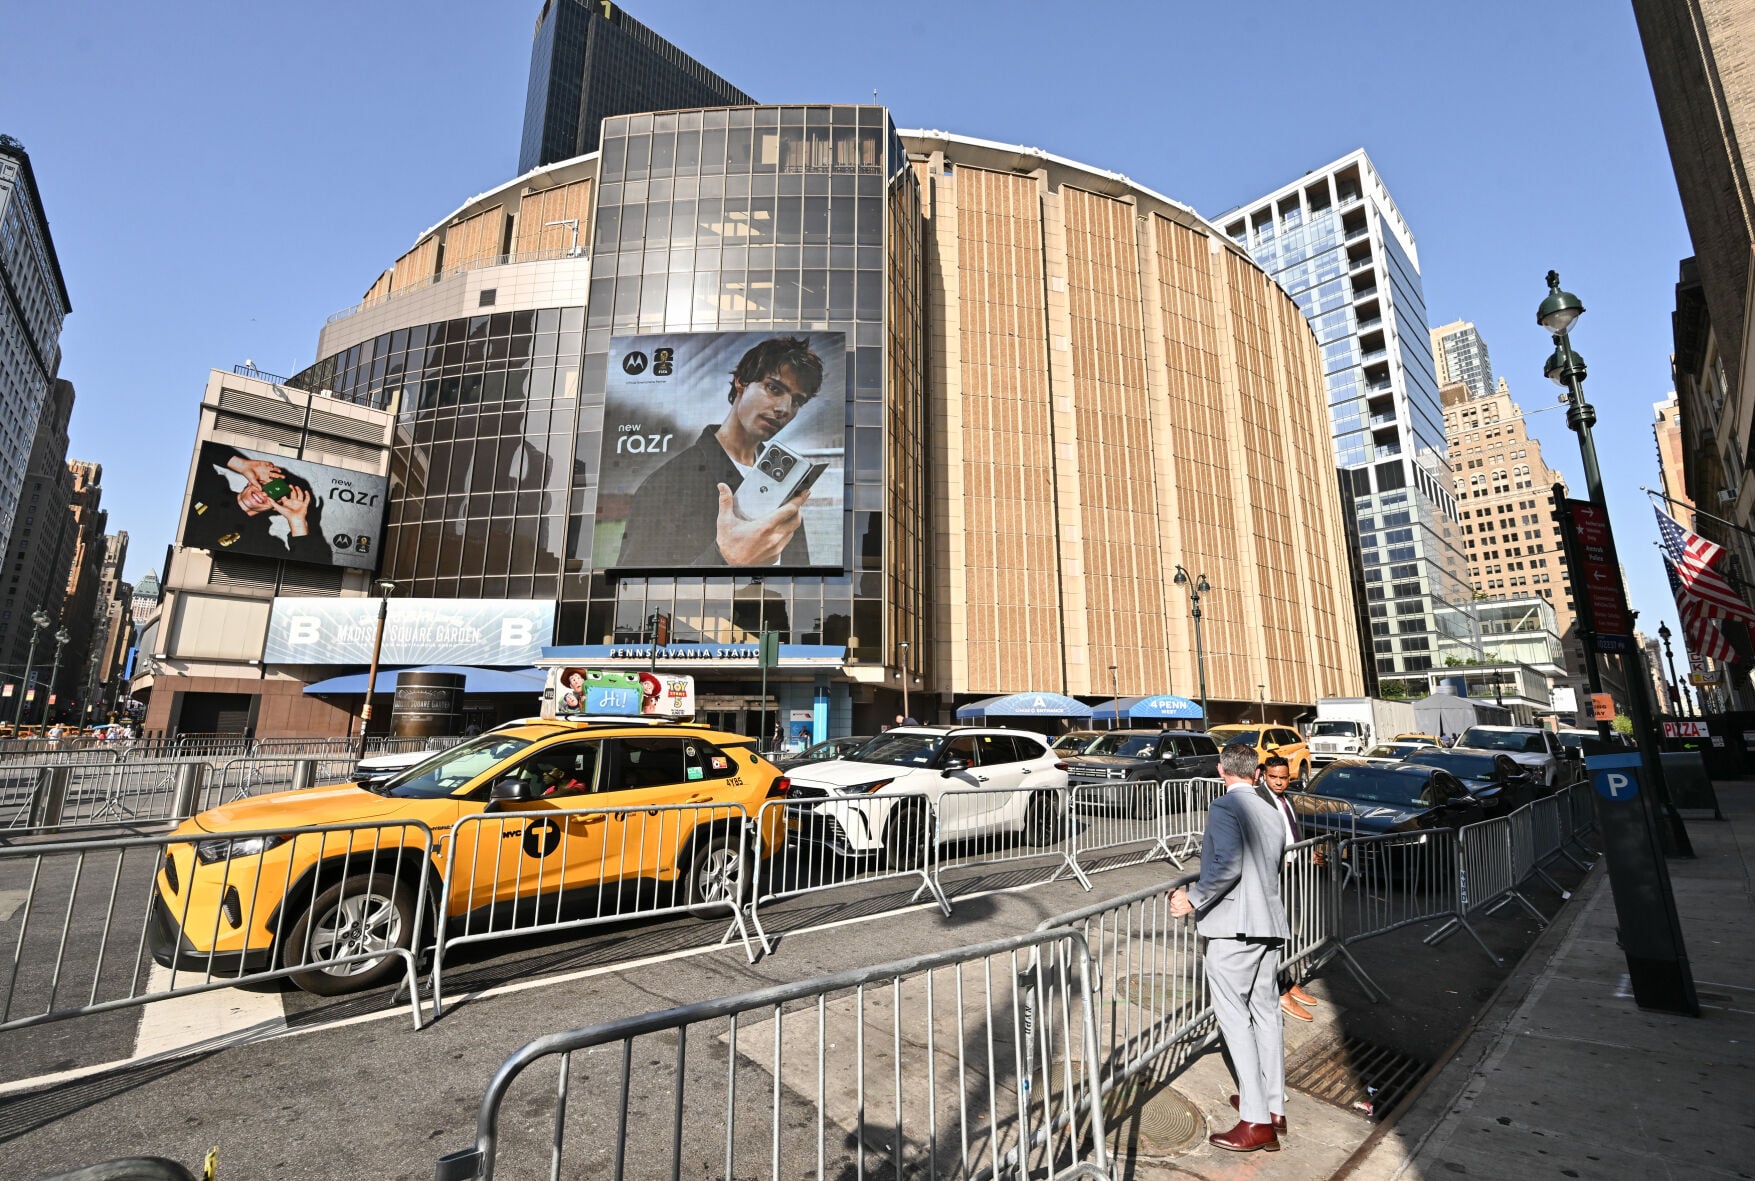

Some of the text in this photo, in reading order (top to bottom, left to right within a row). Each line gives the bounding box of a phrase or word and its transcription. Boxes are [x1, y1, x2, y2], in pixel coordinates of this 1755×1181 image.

[600, 0, 611, 20] 1
[618, 423, 642, 432] new
[616, 434, 673, 454] razr
[331, 478, 352, 487] new
[329, 487, 379, 507] razr
[288, 616, 321, 645] B
[389, 624, 433, 642] SQUARE
[435, 625, 481, 642] GARDEN
[501, 617, 533, 646] B
[610, 648, 760, 658] PENNSYLVANIA STATIO
[667, 680, 688, 691] TOY
[599, 689, 627, 708] Hi!
[674, 697, 683, 708] 5
[1033, 695, 1046, 707] A
[1151, 700, 1187, 709] 4 PENN
[1664, 722, 1700, 737] PIZZA
[1607, 773, 1629, 797] P
[502, 829, 522, 839] NYC
